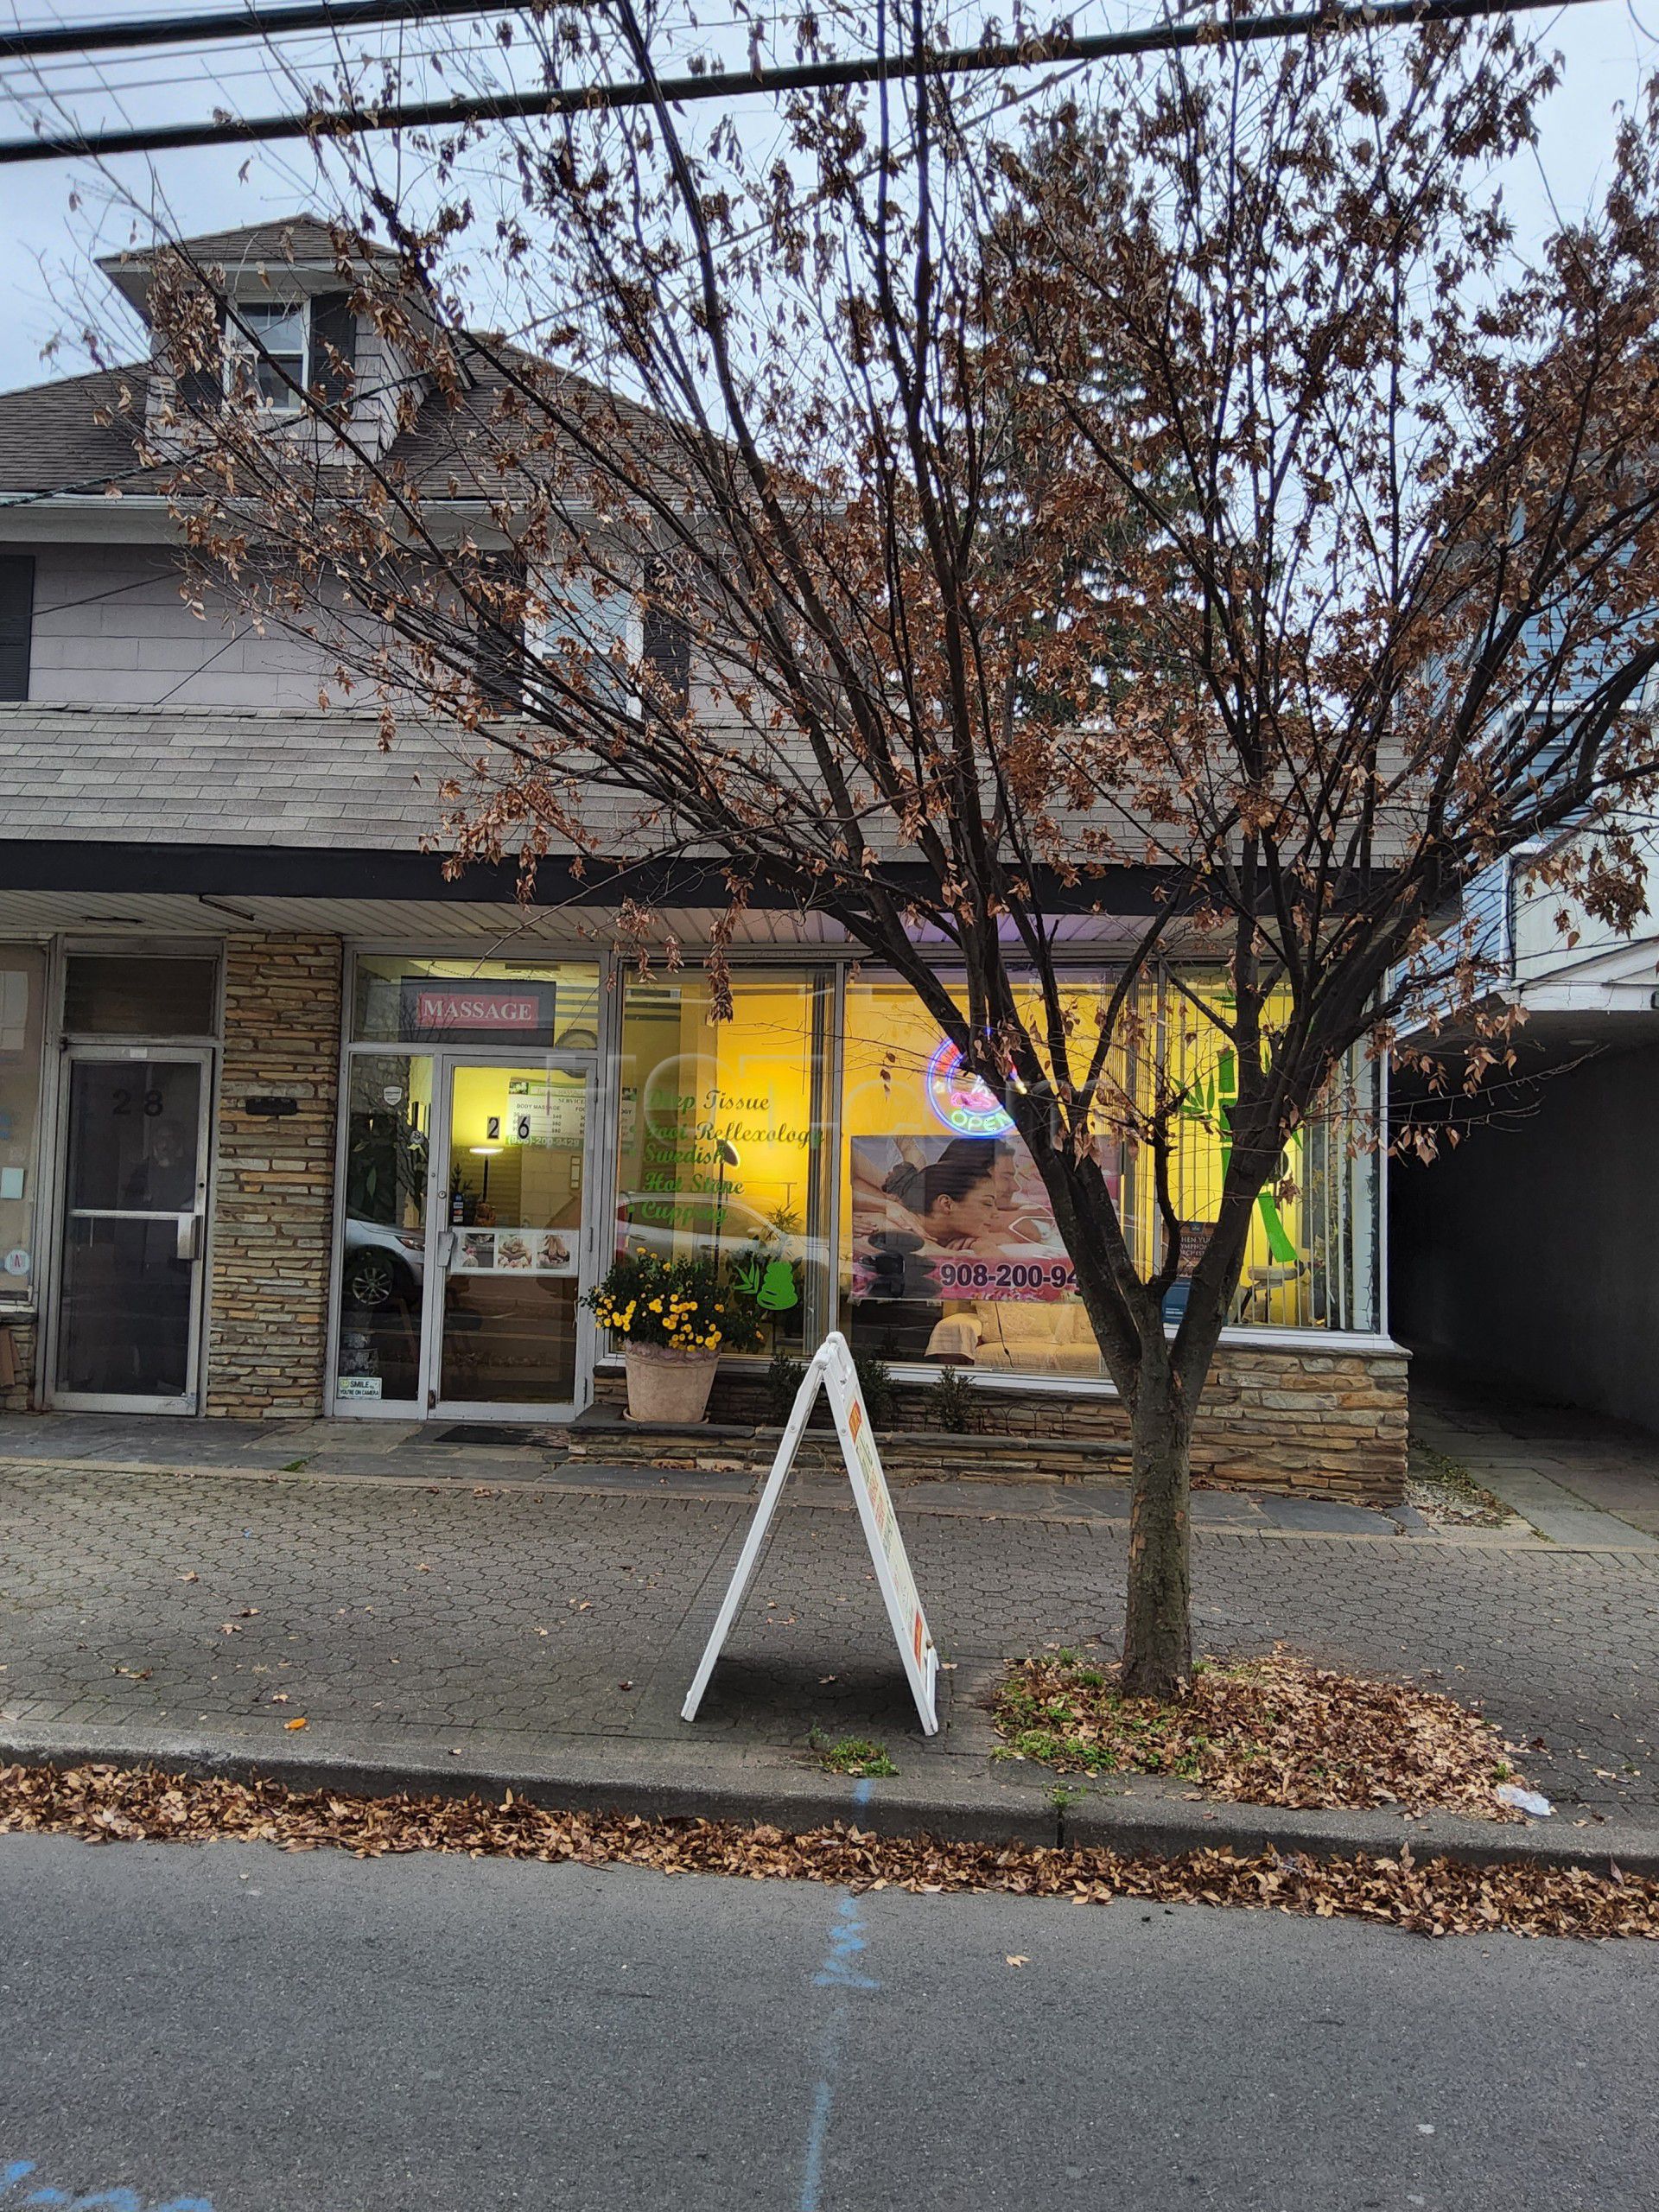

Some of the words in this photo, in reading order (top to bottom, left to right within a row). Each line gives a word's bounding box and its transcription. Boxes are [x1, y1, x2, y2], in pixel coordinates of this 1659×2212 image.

[423, 1000, 531, 1020] MASSAGE
[112, 1089, 163, 1116] 28
[649, 1088, 696, 1115] Deep
[703, 1089, 770, 1110] Tissue
[951, 1109, 1014, 1132] OPEN
[694, 1120, 825, 1149] Reflexology
[643, 1144, 726, 1165] Swedish
[642, 1173, 683, 1192] Hot
[690, 1173, 745, 1194] Stone
[940, 1263, 1079, 1288] 908-200-94
